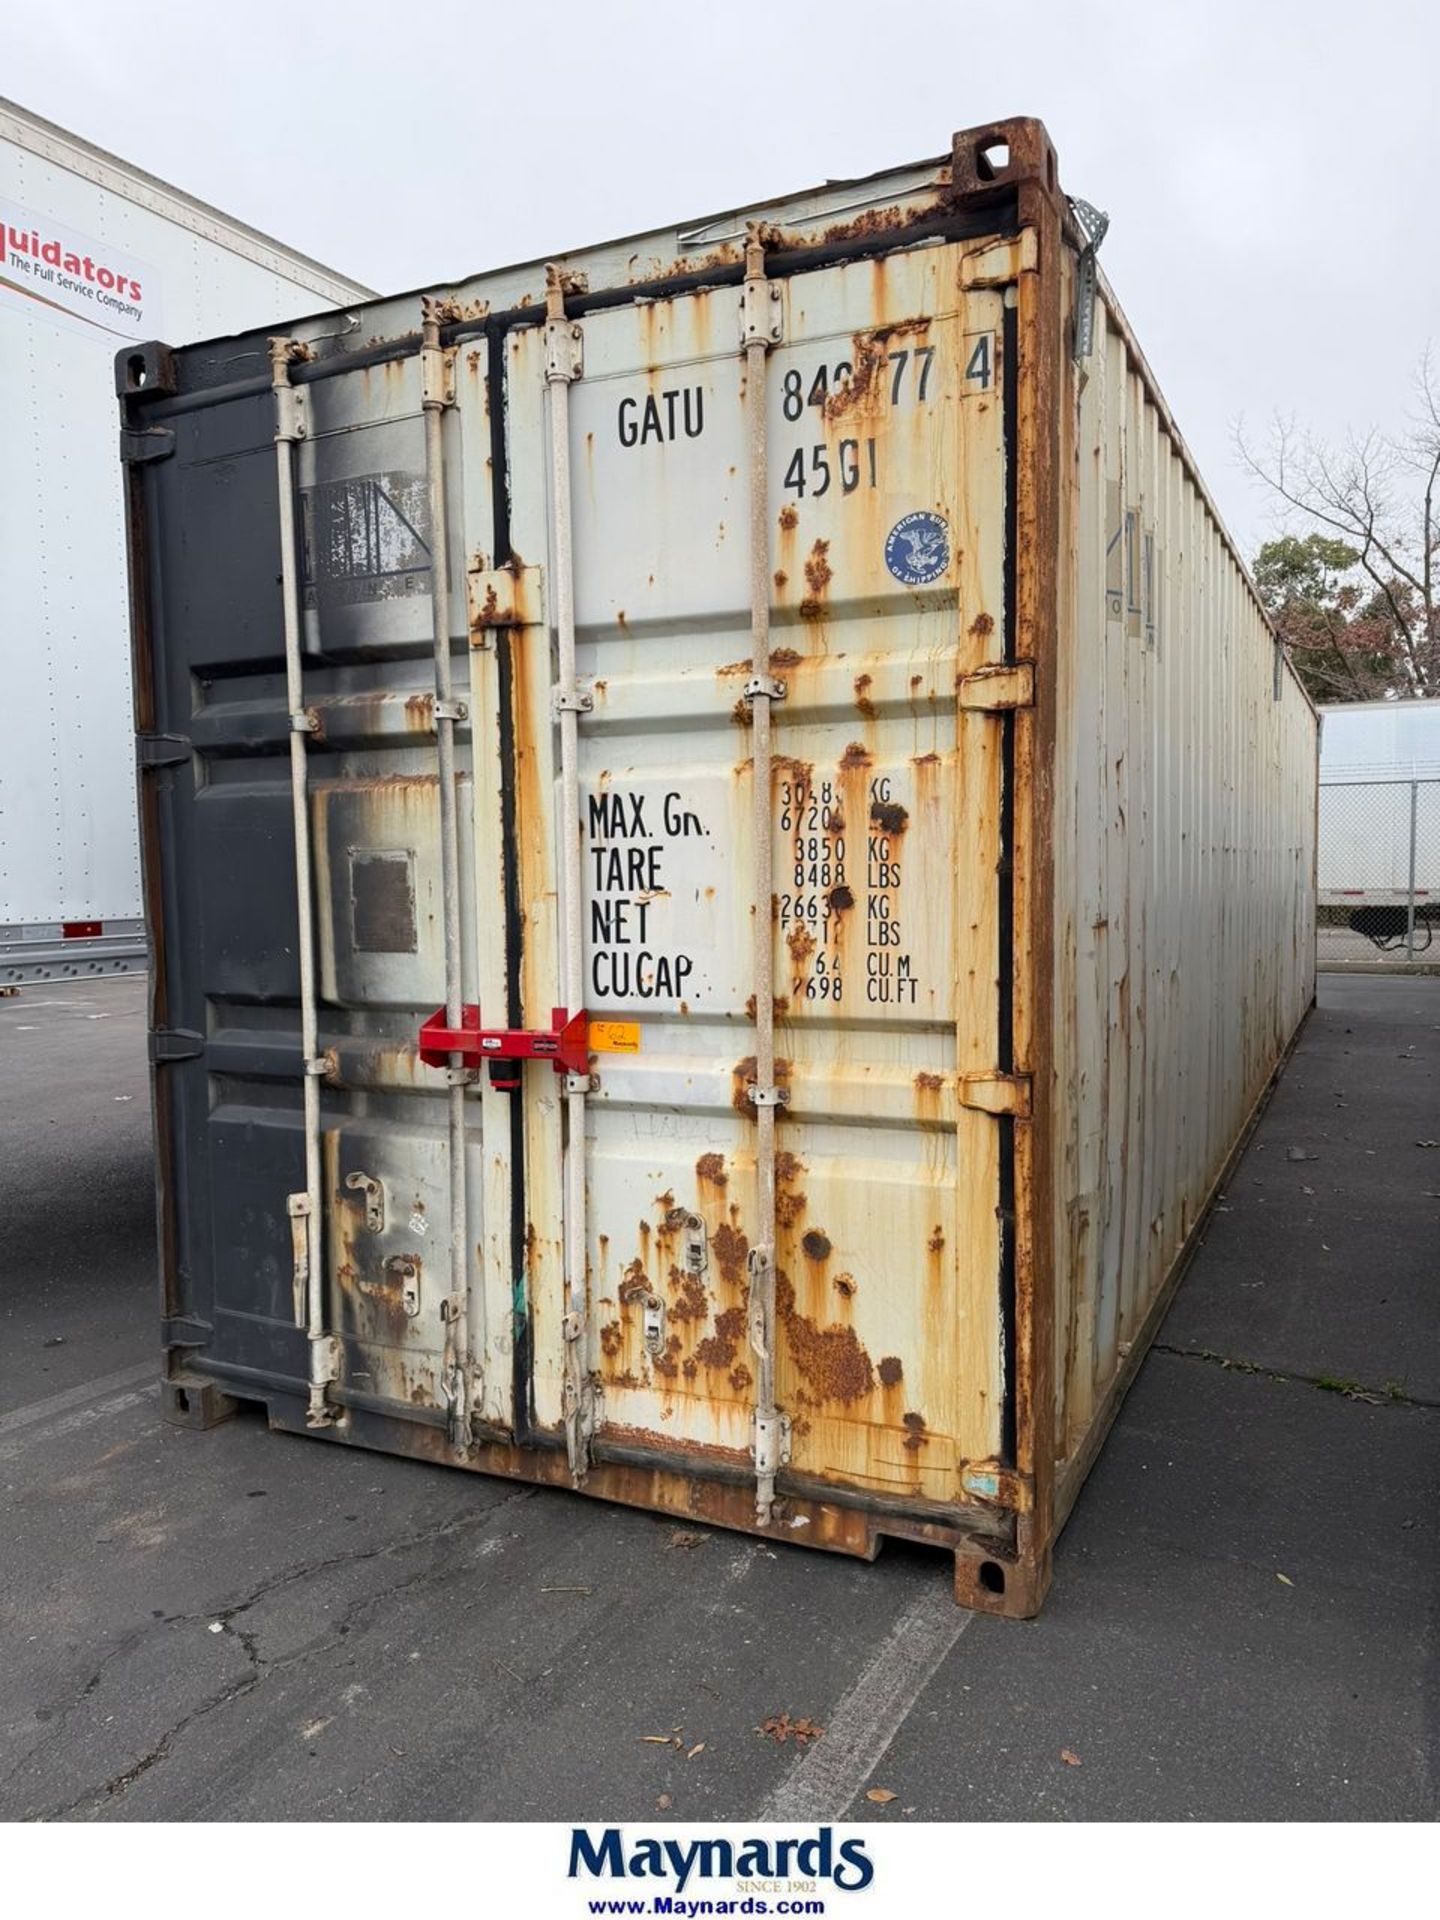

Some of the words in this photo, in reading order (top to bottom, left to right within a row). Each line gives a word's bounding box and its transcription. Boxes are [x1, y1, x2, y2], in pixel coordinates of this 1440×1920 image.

[9, 252, 31, 273] The
[33, 263, 54, 283] Full
[57, 273, 94, 299] Service
[96, 290, 143, 322] Company
[618, 386, 704, 448] GATU
[783, 345, 936, 422] 8477
[965, 335, 991, 389] 4
[588, 792, 653, 839] MAX.
[781, 805, 845, 831] 6720
[591, 846, 664, 892] TARE
[795, 837, 845, 861] 3850
[868, 837, 889, 862] KG
[794, 863, 845, 888] 8488
[868, 864, 901, 888] LBS
[591, 899, 651, 945] NET
[781, 894, 846, 920] 2663
[868, 895, 889, 919] KG
[868, 920, 901, 946] LBS
